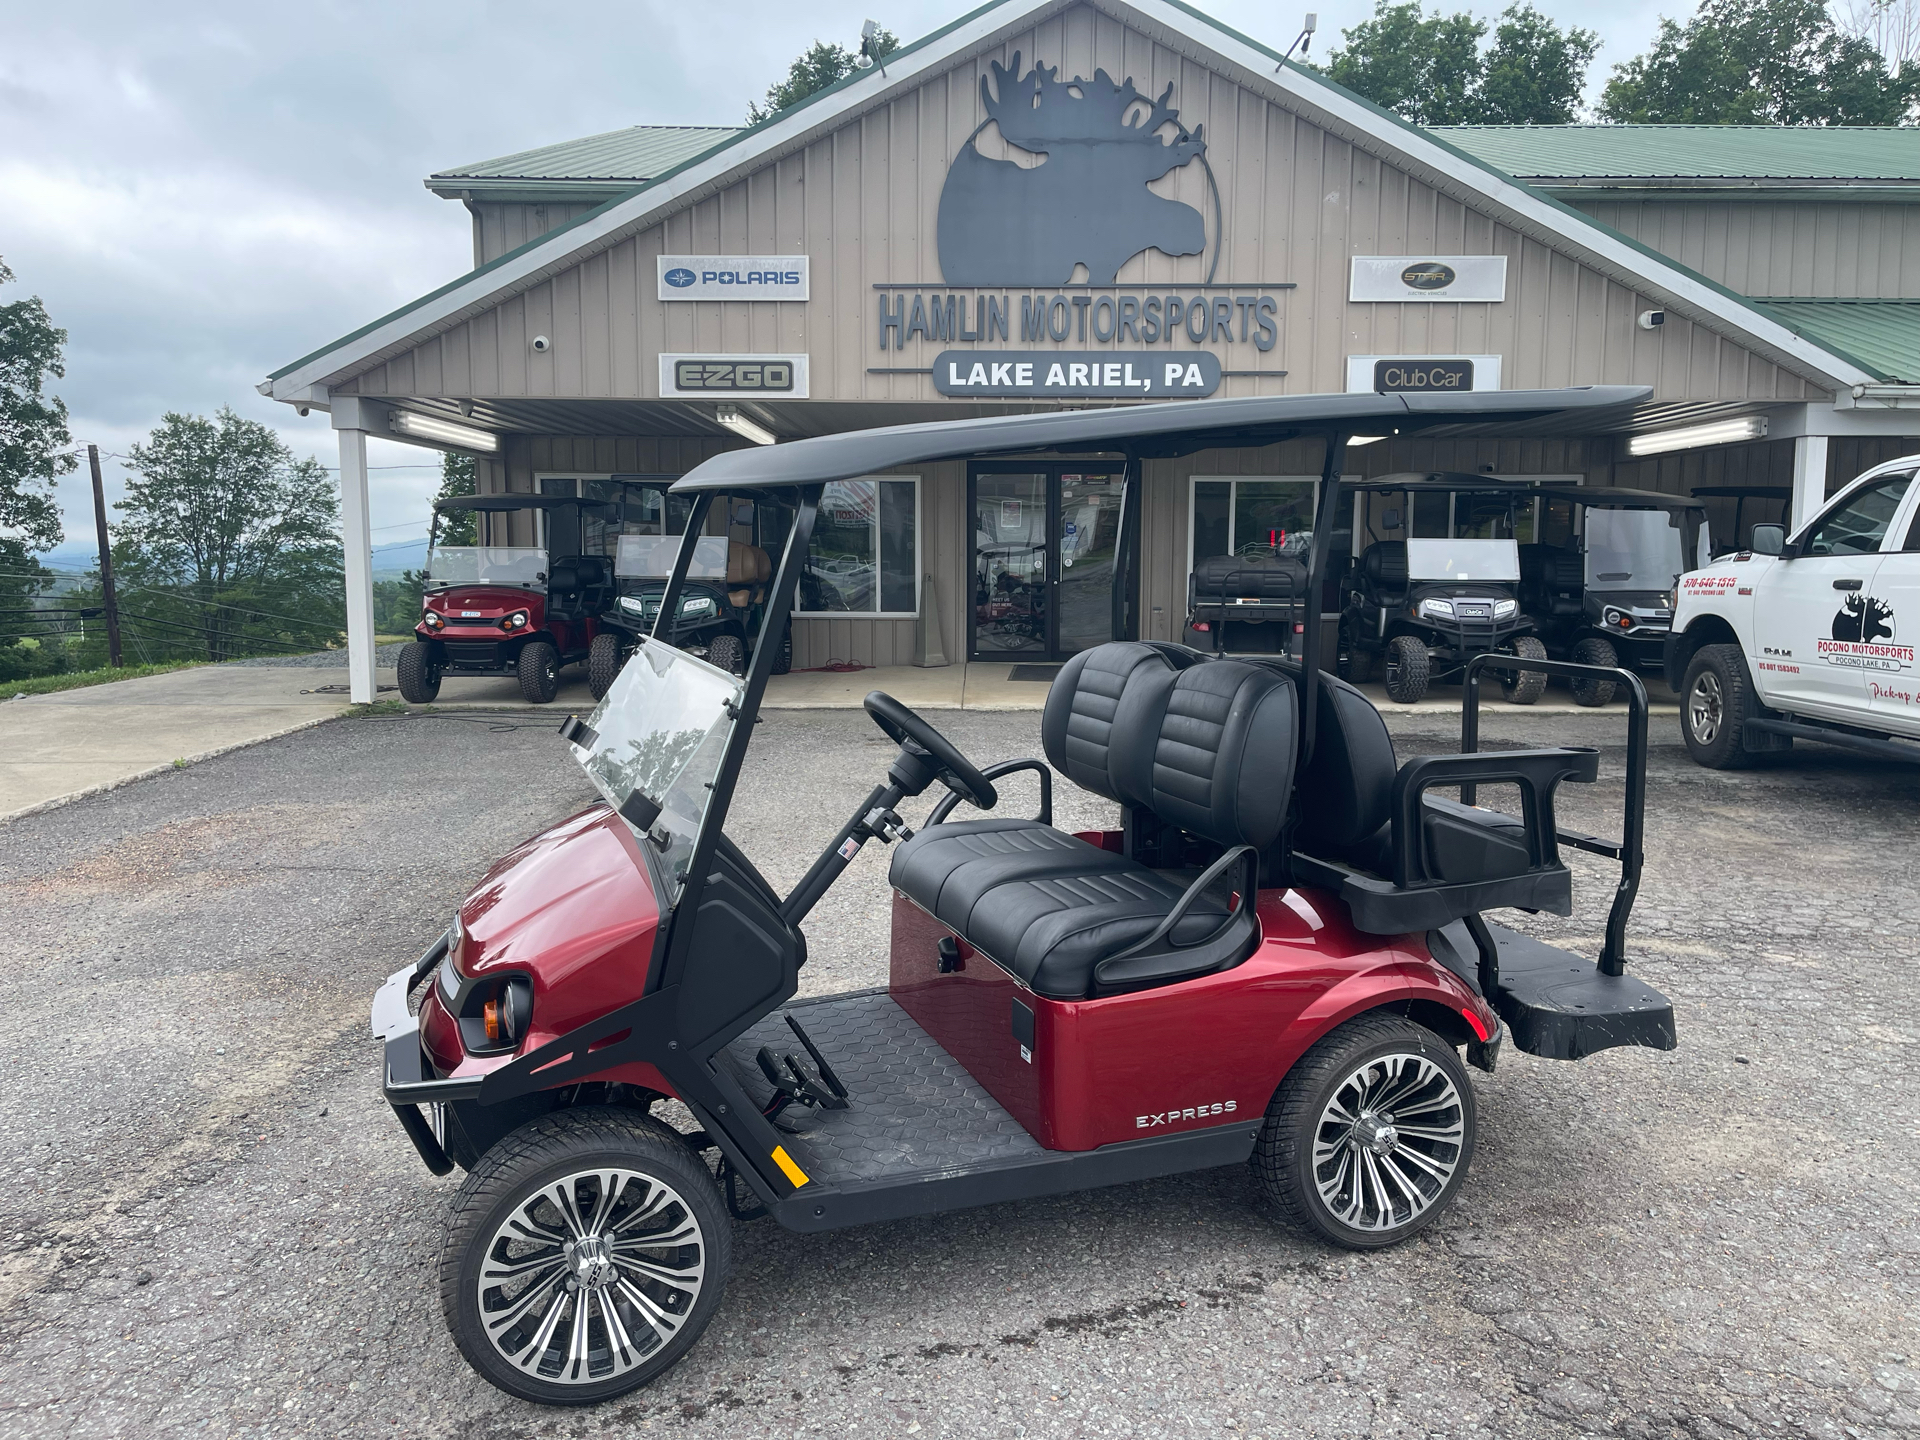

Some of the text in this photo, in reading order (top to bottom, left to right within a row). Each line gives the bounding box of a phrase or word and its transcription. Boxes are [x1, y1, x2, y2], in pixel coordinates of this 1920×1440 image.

[702, 271, 801, 285] POLARIS
[1404, 272, 1446, 281] STAR
[879, 293, 1279, 352] HAMLIN MOTORSPORTS
[678, 364, 790, 387] EZGO
[948, 362, 1205, 392] LAKE ARIEL, PA
[1384, 367, 1463, 388] Club Car
[1683, 577, 1738, 588] 570-646-1515
[1763, 647, 1792, 657] RAM
[1817, 641, 1914, 662] POCONO MOTORSPORTS
[1758, 662, 1766, 670] US
[1766, 663, 1776, 671] DOT
[1835, 656, 1891, 669] POCONO LAKE, PA
[1869, 682, 1911, 705] Pick-up
[1135, 1100, 1238, 1129] EXPRESS
